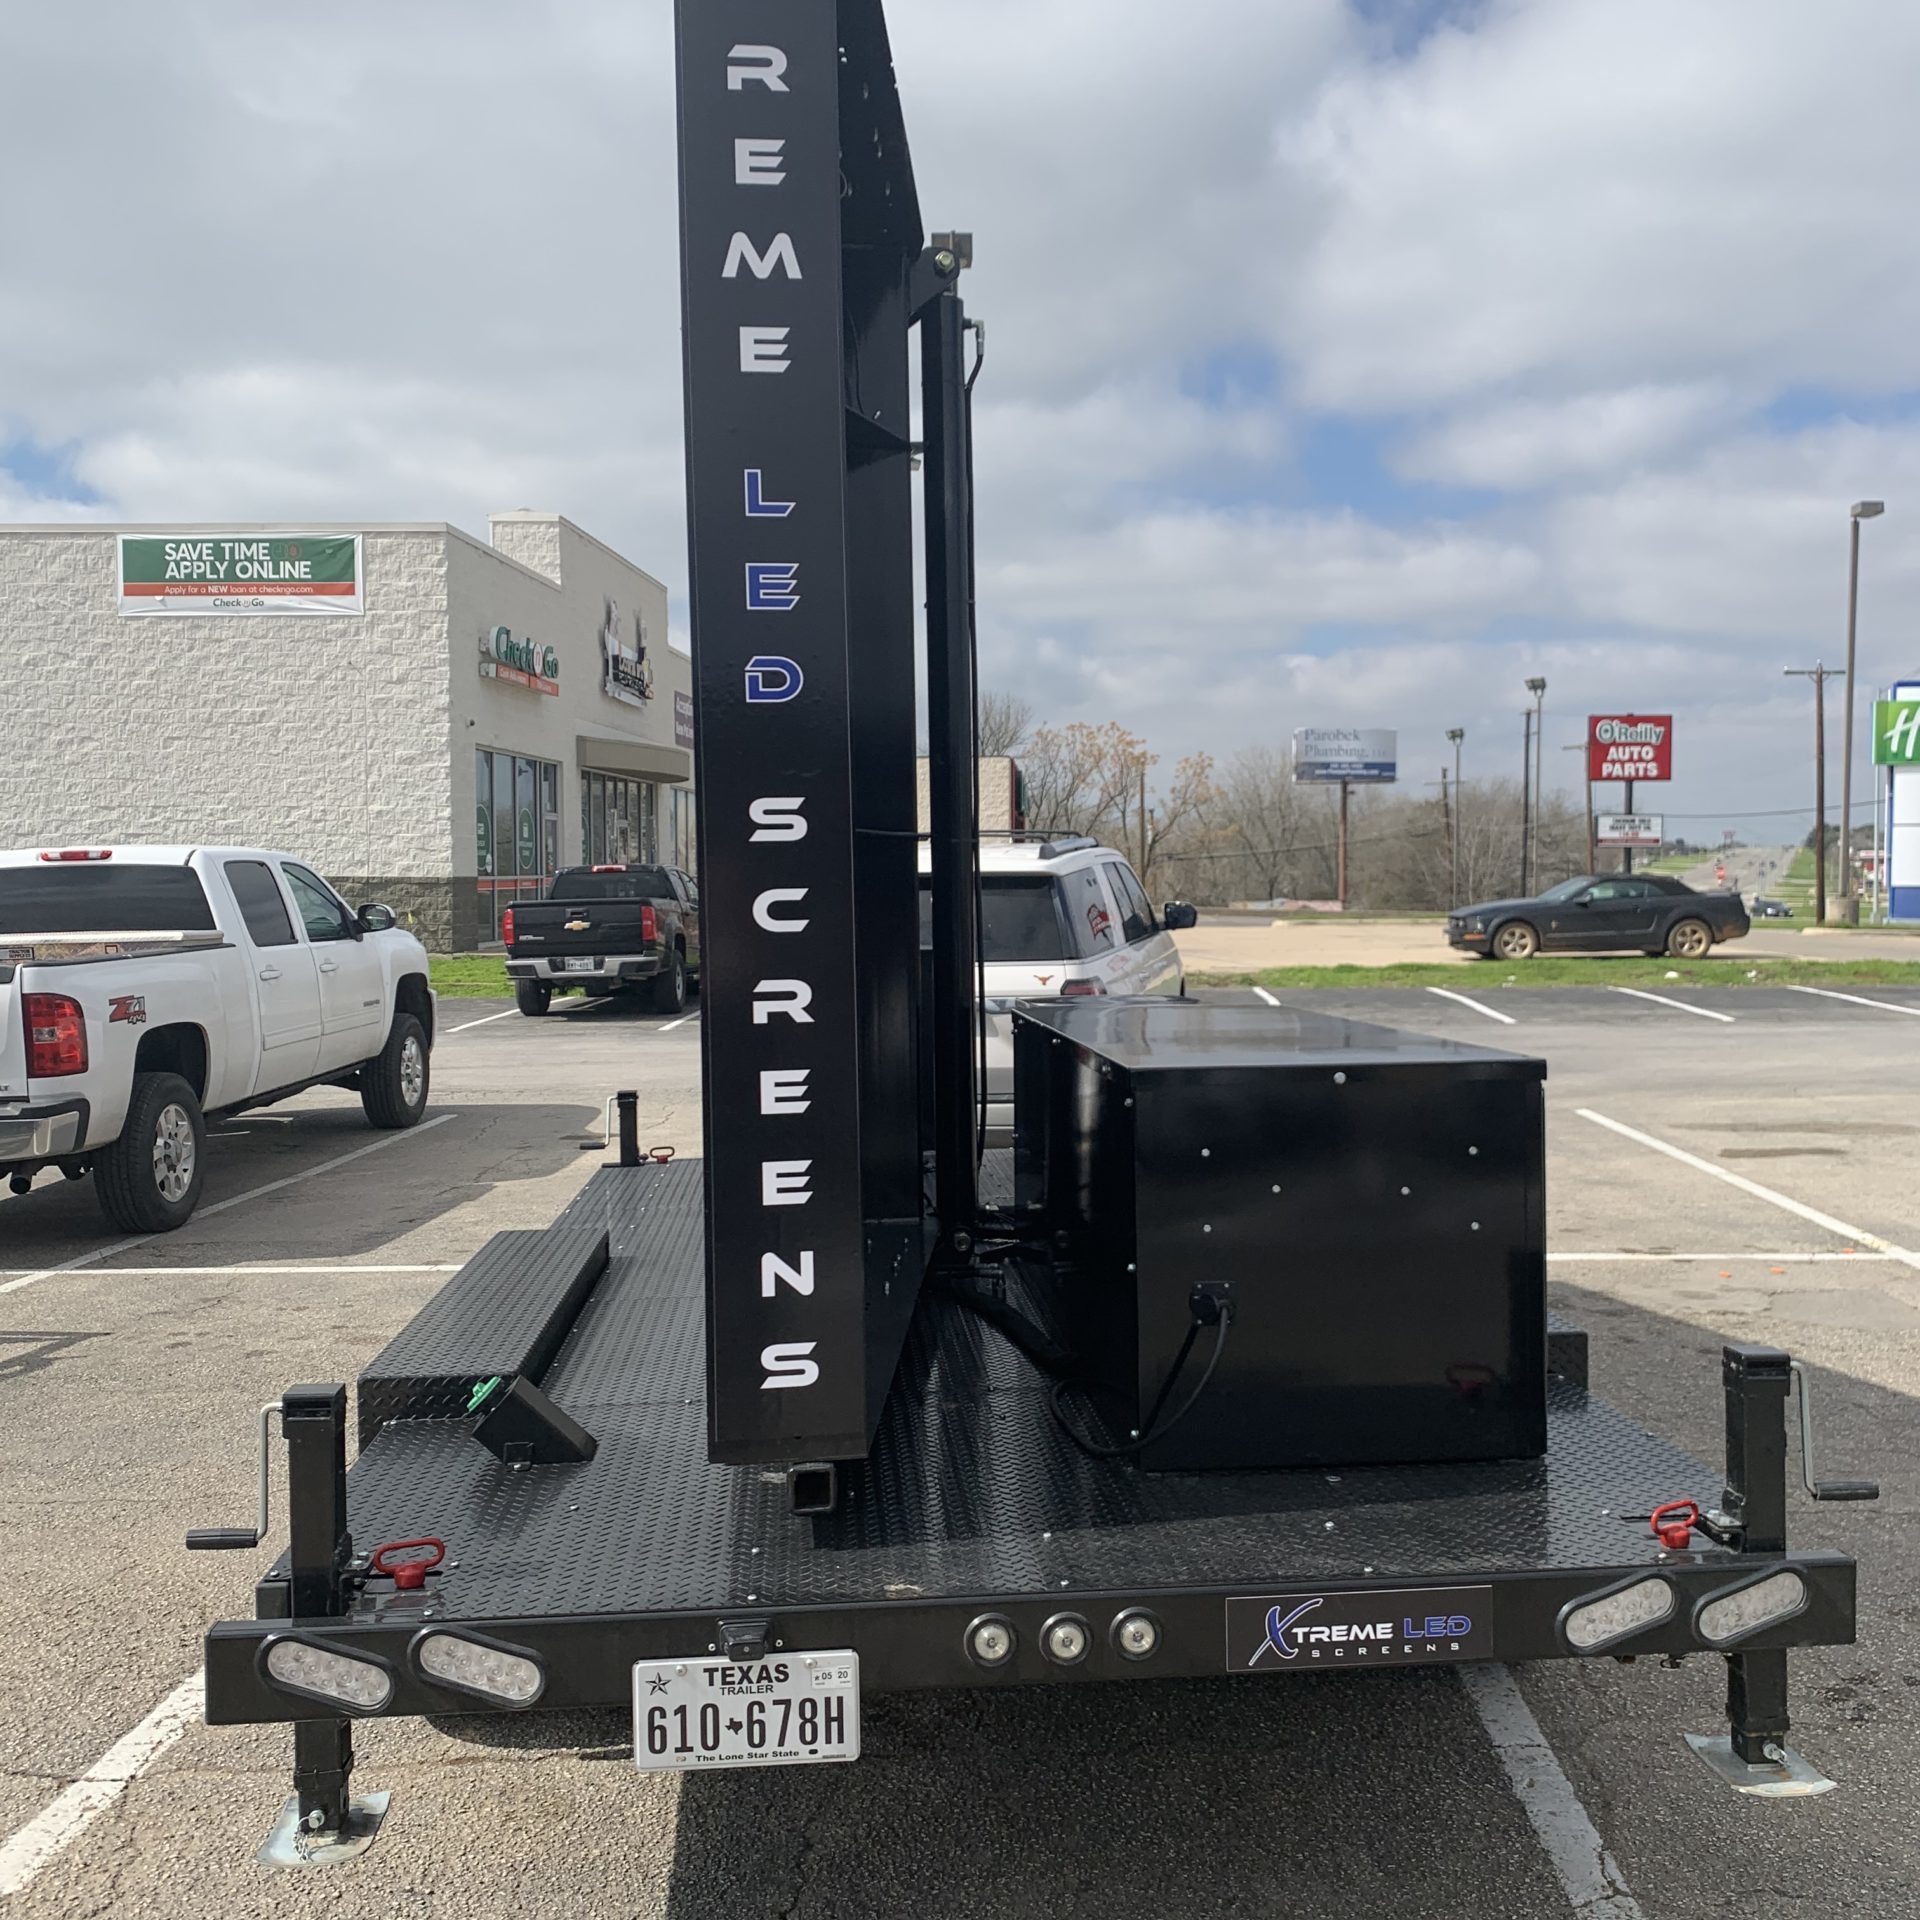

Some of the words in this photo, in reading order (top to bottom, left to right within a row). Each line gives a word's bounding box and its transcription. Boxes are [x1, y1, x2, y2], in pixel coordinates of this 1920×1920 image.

[164, 542, 214, 561] SAVE
[220, 542, 271, 560] TIME
[164, 560, 229, 579] APPLY
[235, 560, 312, 579] ONLINE
[164, 585, 186, 595] Apply
[187, 585, 198, 593] for
[207, 585, 228, 593] NEW
[230, 585, 247, 593] loan
[258, 585, 314, 595] checkngo.com
[744, 468, 804, 704] LED
[213, 598, 241, 607] Check
[251, 598, 265, 607] Go
[496, 626, 533, 675] Check
[544, 645, 560, 679] Go
[1596, 718, 1664, 745] O'Reilly
[1606, 745, 1654, 761] AUTO
[1601, 761, 1658, 777] PARTS
[108, 995, 145, 1023] Z71
[748, 797, 820, 1390] SCREENS
[1248, 1597, 1394, 1667] XTREME
[1403, 1614, 1472, 1639] LED
[1311, 1641, 1460, 1658] SCREENS
[703, 1663, 790, 1687] TEXAS
[821, 1671, 833, 1680] 05
[837, 1670, 849, 1679] 20
[719, 1684, 774, 1696] TRAILER
[647, 1703, 720, 1755] 610
[746, 1695, 844, 1749] 678H
[695, 1754, 717, 1762] The
[718, 1752, 745, 1761] Lone
[747, 1751, 770, 1759] Star
[772, 1749, 800, 1758] State
